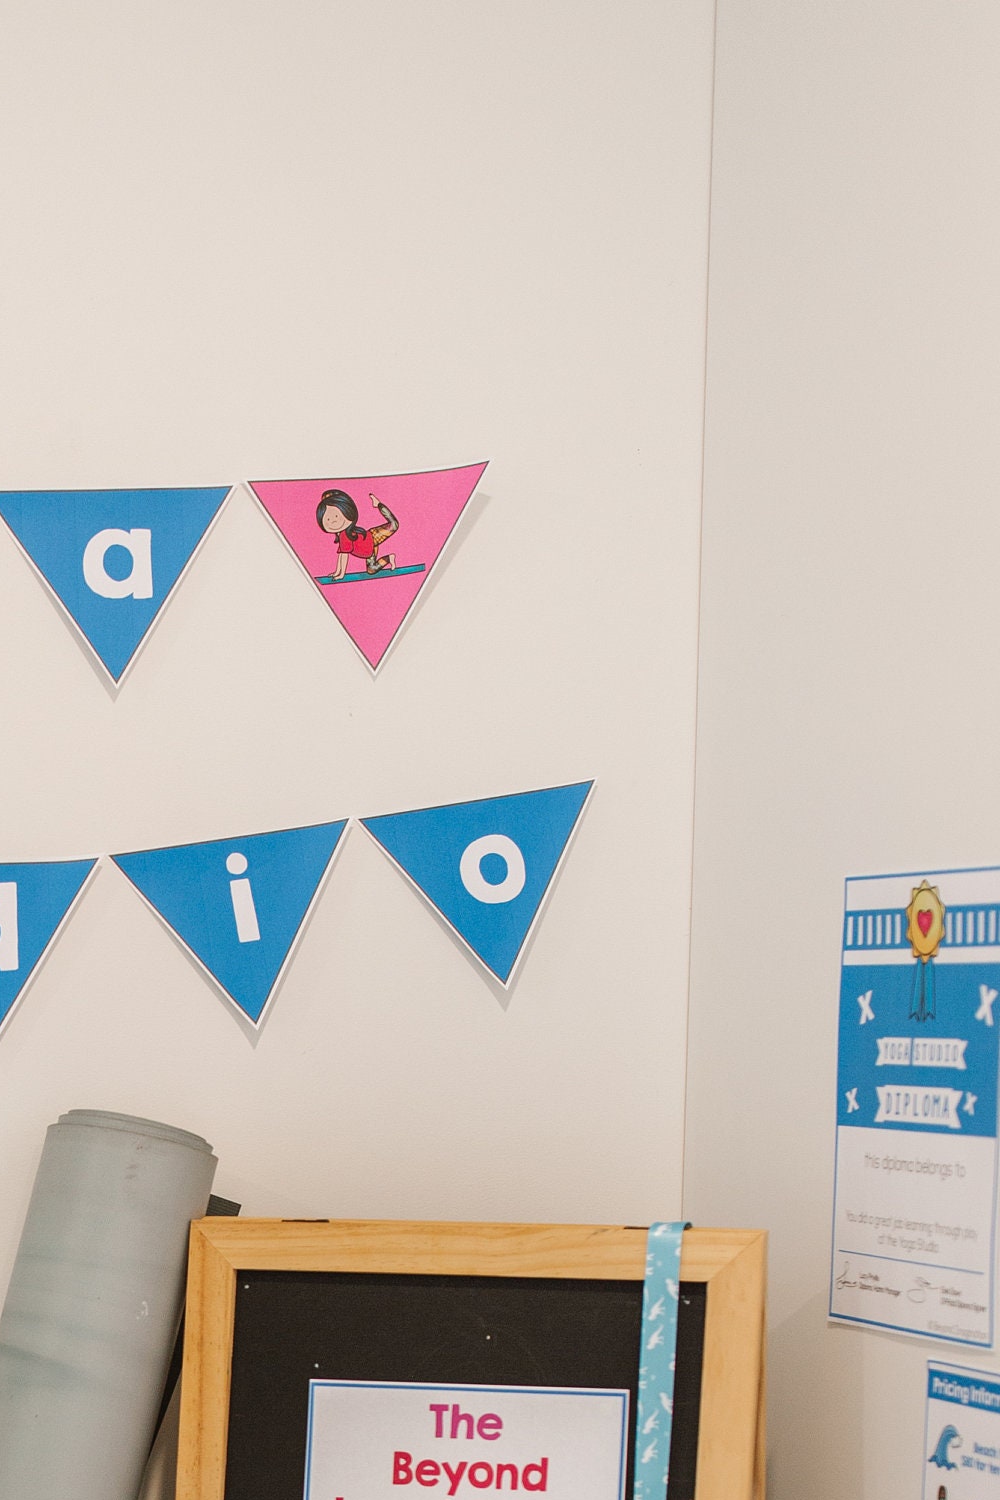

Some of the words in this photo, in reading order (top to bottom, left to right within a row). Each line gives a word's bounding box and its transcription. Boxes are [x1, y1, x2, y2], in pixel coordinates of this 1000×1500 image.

[884, 1042, 909, 1060] YOGA
[915, 1043, 959, 1062] STUDIO
[884, 1092, 950, 1119] DIPLOMA
[933, 1377, 969, 1405] Pricing
[429, 1404, 504, 1441] The
[392, 1451, 548, 1496] Beyond
